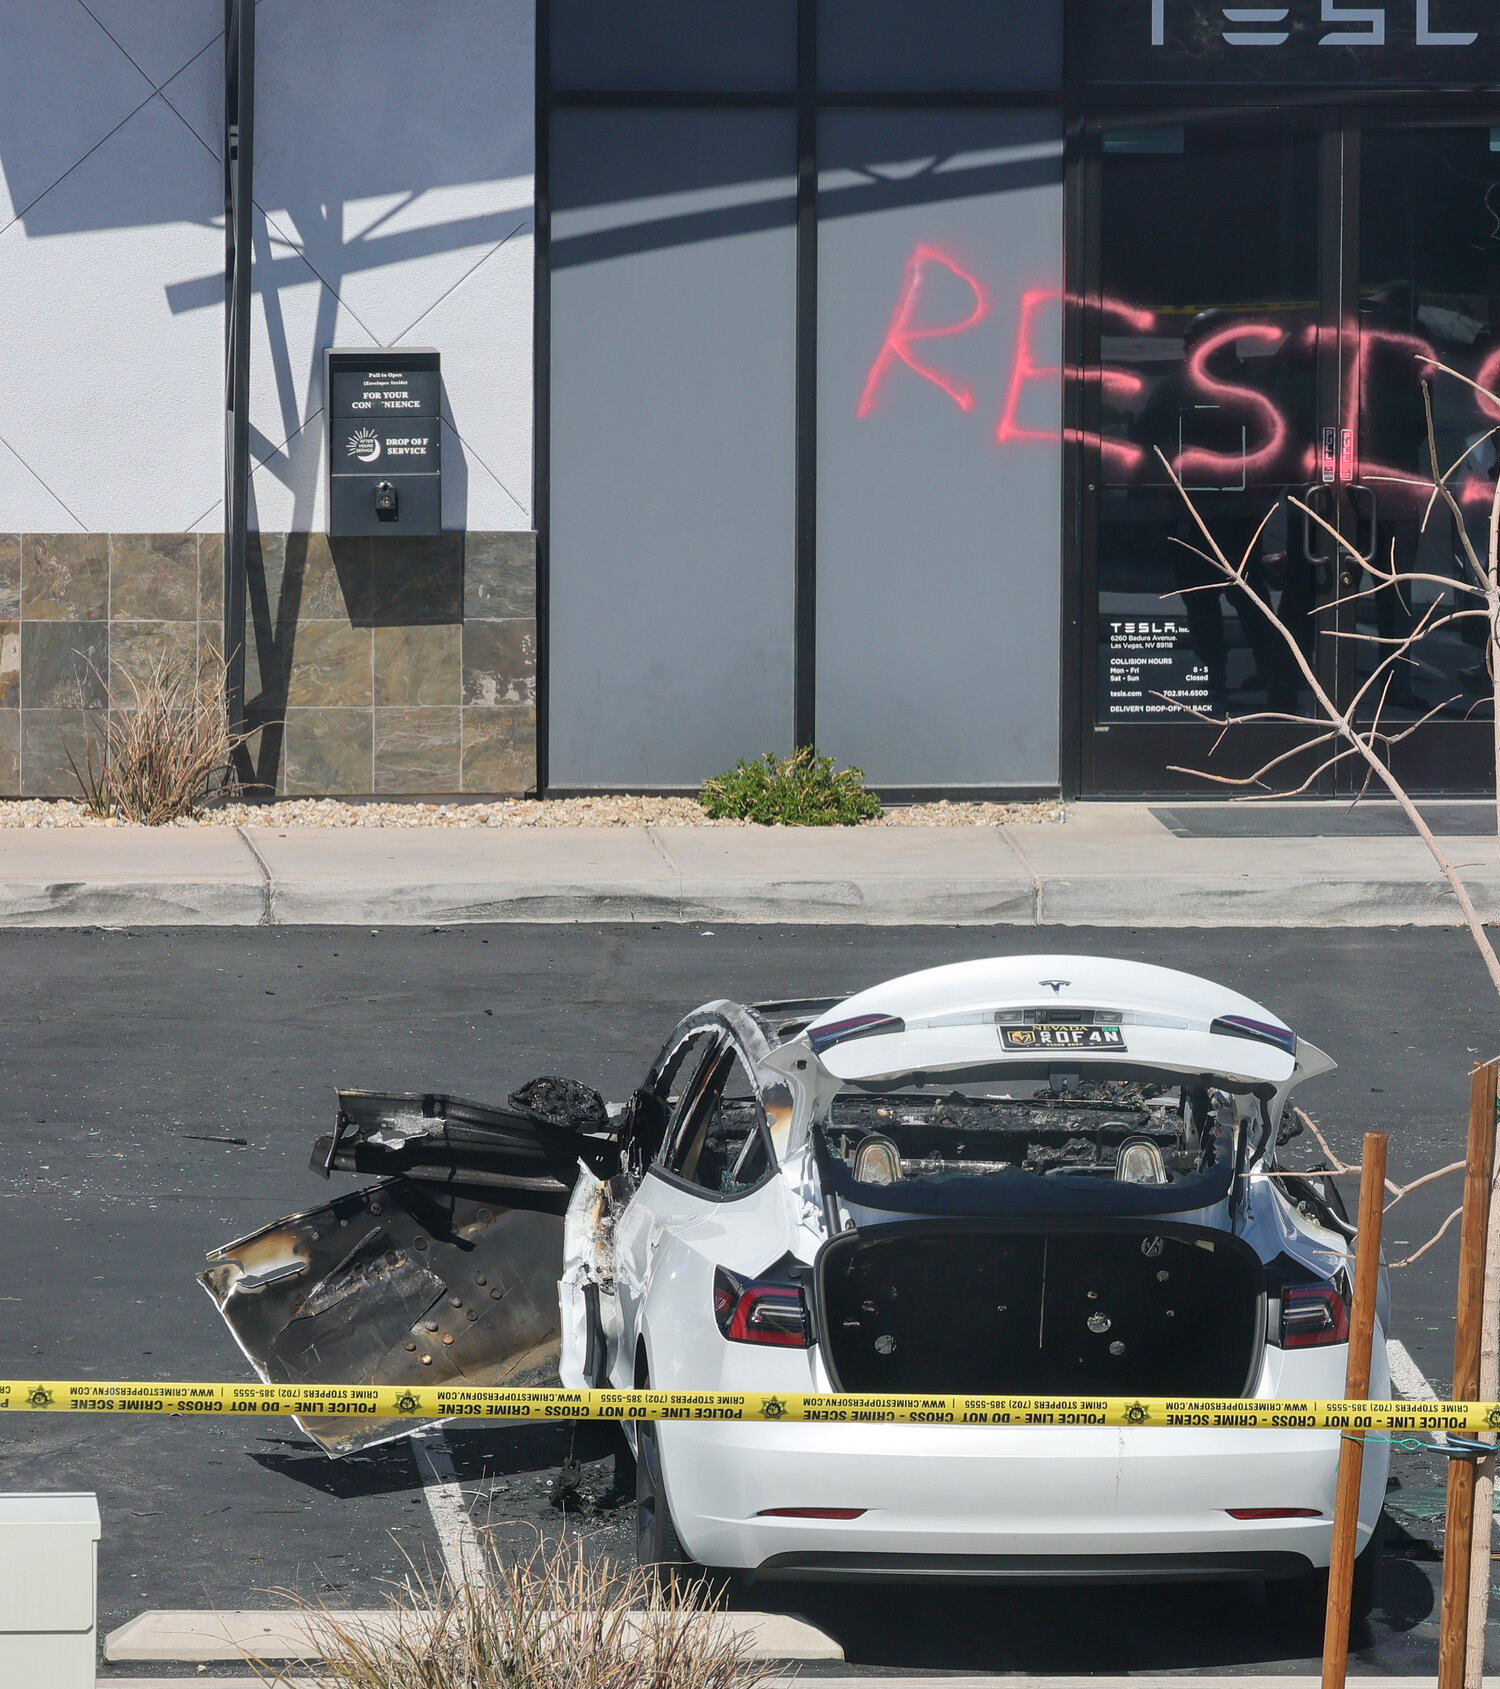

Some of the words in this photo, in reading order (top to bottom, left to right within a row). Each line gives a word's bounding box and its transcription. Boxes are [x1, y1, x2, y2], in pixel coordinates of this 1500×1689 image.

[362, 391, 382, 400] FOR
[382, 391, 409, 399] YOUR
[351, 400, 421, 409] CONNIENCE
[385, 438, 410, 446] DROP
[410, 437, 429, 446] OFF
[1325, 429, 1333, 460] PULL
[387, 447, 427, 455] SERVICE
[1110, 634, 1127, 642] 6260
[1122, 642, 1144, 650] Vegas,
[1163, 689, 1209, 697] 702.914.6500
[1192, 704, 1213, 712] BACK
[232, 1389, 275, 1398] 385-5555
[277, 1388, 301, 1398] (702)
[303, 1389, 348, 1399] STOPPERS
[350, 1390, 379, 1399] CRIME
[599, 1394, 642, 1403] 385-5555
[69, 1399, 115, 1410] SCENE
[644, 1394, 667, 1404] (702)
[669, 1395, 714, 1405] STOPPERS
[716, 1396, 745, 1405] CRIME
[964, 1400, 1006, 1409] 385-5555
[1008, 1399, 1031, 1409] (702)
[118, 1399, 164, 1411] CRIME
[177, 1400, 224, 1412] CROSS
[229, 1401, 258, 1412] NOT
[261, 1401, 281, 1413] DO
[294, 1402, 325, 1413] LINE
[328, 1402, 377, 1414] POLICE
[436, 1404, 482, 1416] SCENE
[484, 1404, 531, 1416] CRIME
[1033, 1401, 1078, 1410] STOPPERS
[1080, 1401, 1108, 1410] CRIME
[1325, 1403, 1367, 1412] 385-5555
[1369, 1403, 1392, 1412] (702)
[1394, 1404, 1439, 1413] STOPPERS
[1441, 1405, 1469, 1413] CRIME
[544, 1405, 590, 1417] CROSS
[596, 1406, 624, 1418] NOT
[627, 1406, 647, 1418] DO
[661, 1407, 691, 1419] LINE
[694, 1407, 743, 1420] POLICE
[802, 1410, 847, 1421] SCENE
[850, 1410, 896, 1422] CRIME
[909, 1411, 955, 1423] CROSS
[960, 1412, 988, 1423] NOT
[992, 1412, 1011, 1424] DO
[1025, 1413, 1054, 1424] LINE
[1058, 1413, 1106, 1425] POLICE
[1165, 1414, 1210, 1426] SCENE
[1213, 1414, 1258, 1427] CRIME
[1271, 1415, 1317, 1428] CROSS
[1322, 1415, 1350, 1428] NOT
[1353, 1415, 1373, 1428] DO
[1386, 1416, 1416, 1429] LINE
[1419, 1416, 1467, 1429] POLICE
